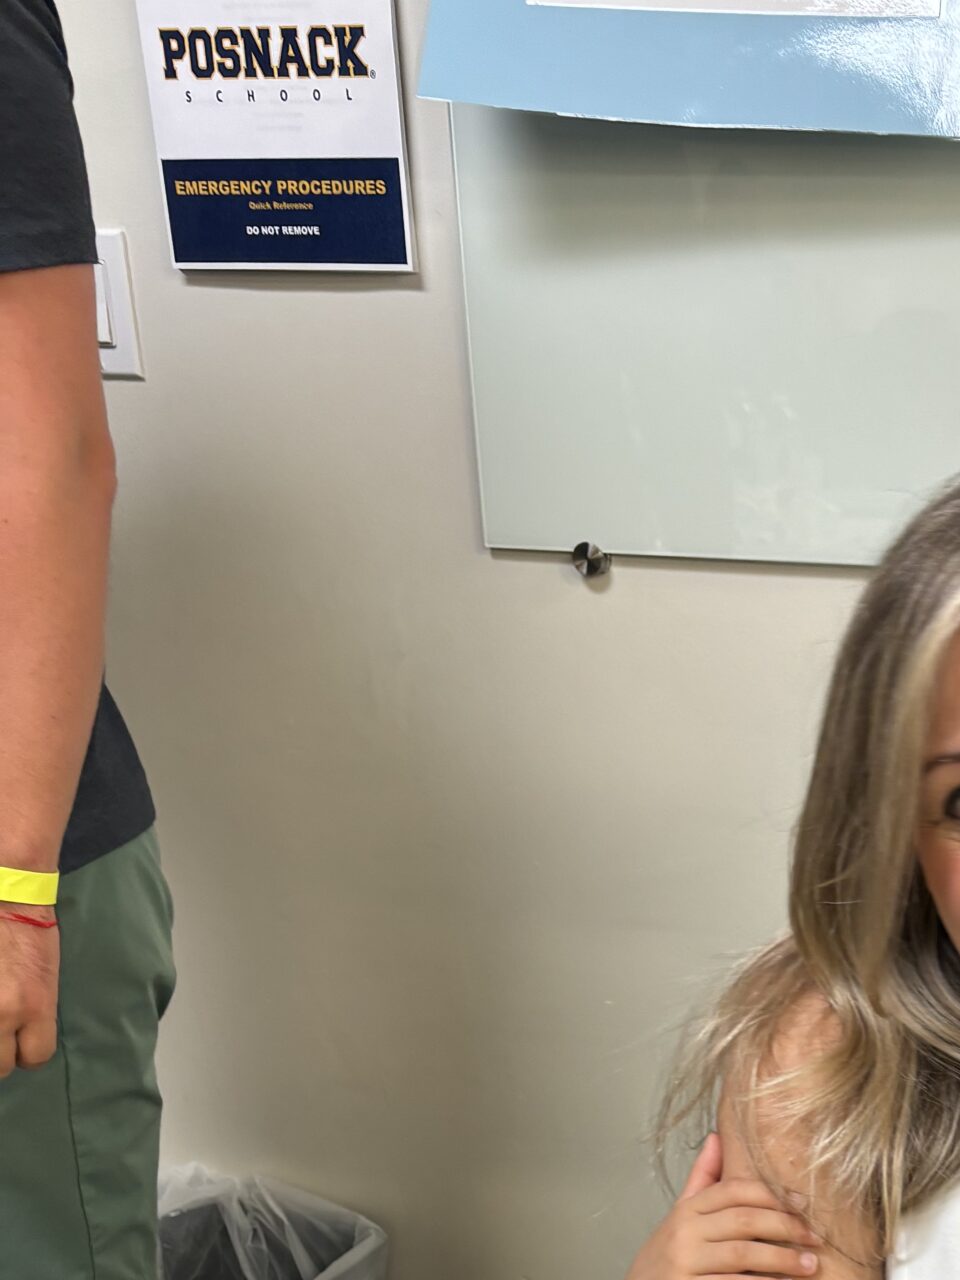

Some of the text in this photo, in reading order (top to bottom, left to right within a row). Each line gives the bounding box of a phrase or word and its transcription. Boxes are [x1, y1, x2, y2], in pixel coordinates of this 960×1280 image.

[185, 88, 353, 102] SCHOOL
[174, 179, 386, 196] EMERGENCY PROCEDURES
[249, 201, 313, 210] Quick Reference
[246, 226, 320, 235] DO NOT REMOVE
